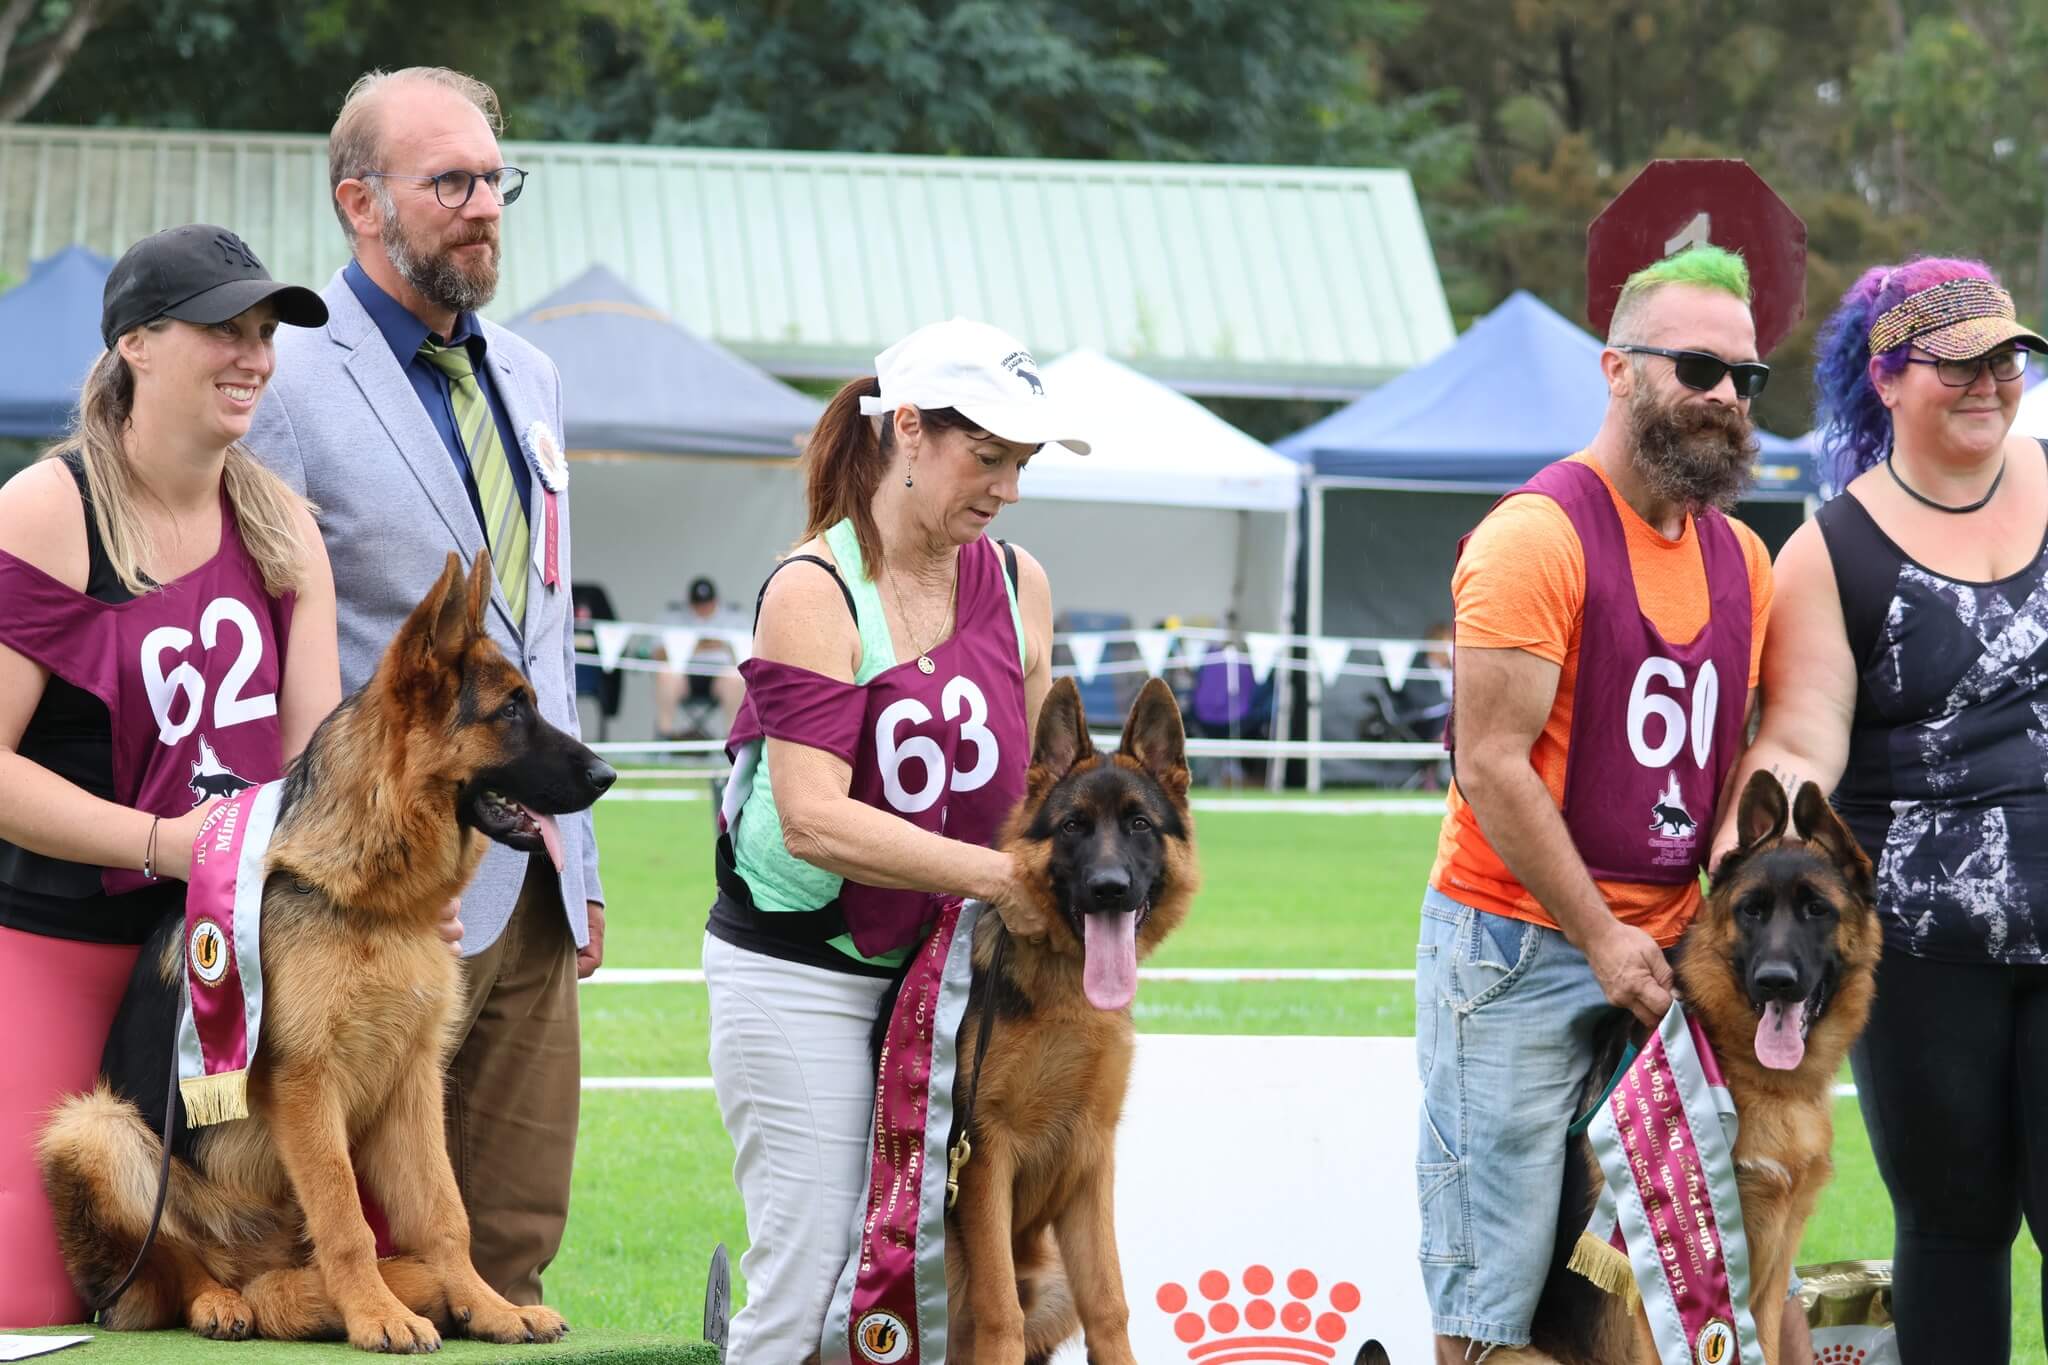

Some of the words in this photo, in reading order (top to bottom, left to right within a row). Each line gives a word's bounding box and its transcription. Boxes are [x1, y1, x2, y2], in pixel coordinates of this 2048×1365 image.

[141, 597, 278, 746] 62
[1627, 656, 1719, 770] 60
[876, 675, 1000, 813] 63
[1614, 1089, 1631, 1123] Dog
[1642, 1056, 1669, 1102] Stock
[1623, 1125, 1655, 1197] Shepherd
[1664, 1115, 1685, 1151] Dog
[905, 1135, 921, 1192] Puppy
[1677, 1152, 1703, 1206] Puppy
[1660, 1164, 1690, 1231] CHRISTOPH
[1649, 1199, 1678, 1261] German
[1695, 1208, 1718, 1260] Minor
[1669, 1262, 1689, 1295] 51st
